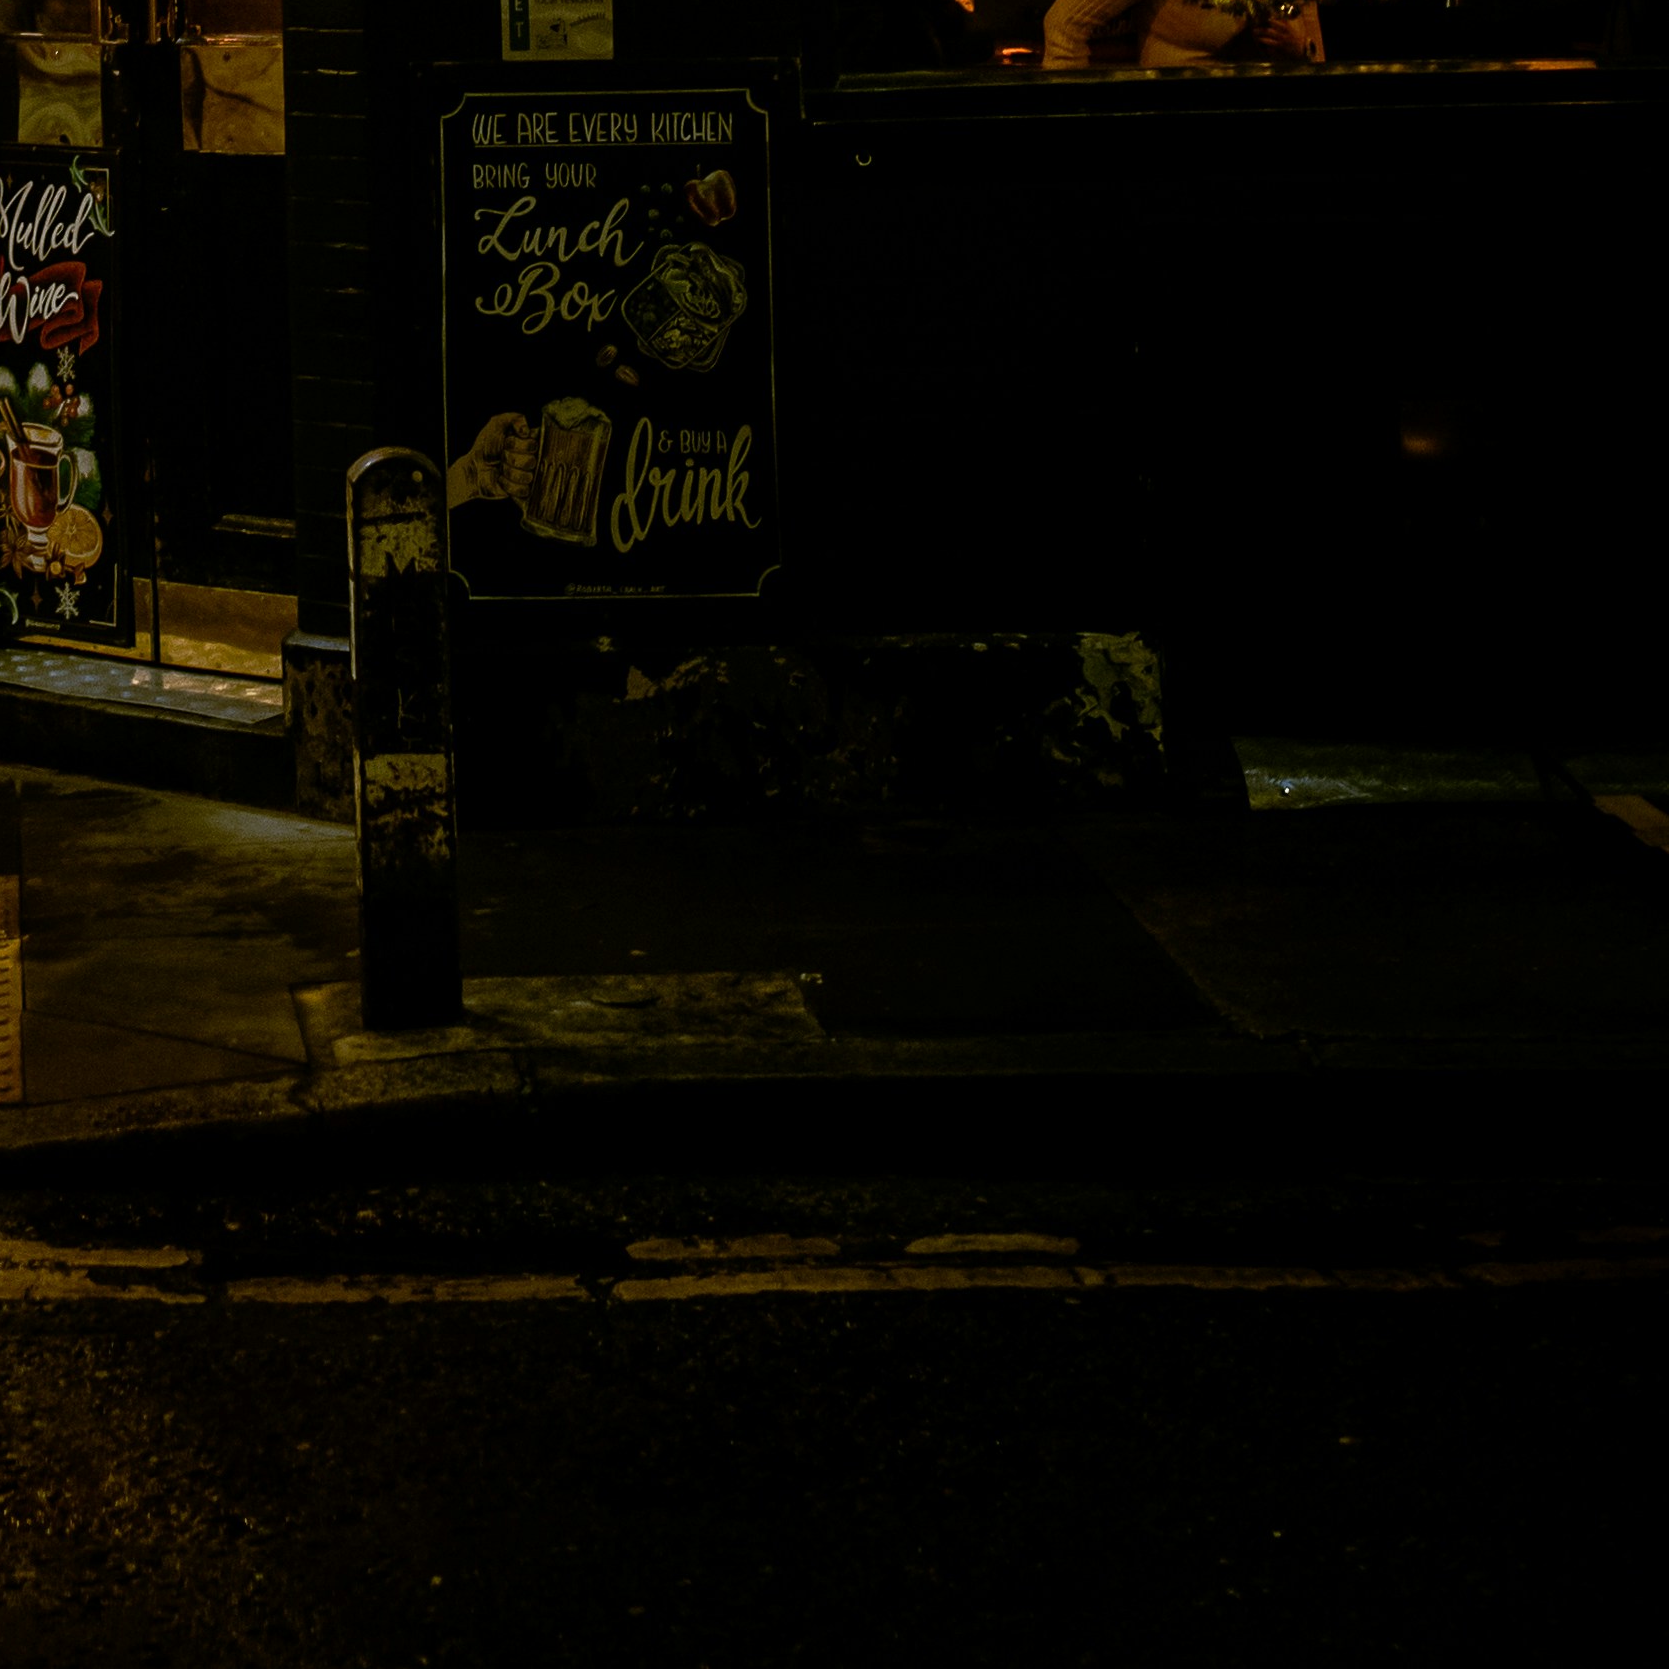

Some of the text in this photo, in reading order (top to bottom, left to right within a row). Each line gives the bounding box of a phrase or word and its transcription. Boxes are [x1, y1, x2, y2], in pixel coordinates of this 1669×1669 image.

[471, 111, 734, 145] WE ARE EVERY KITCHEN
[472, 162, 598, 189] BRING YOUR
[473, 195, 646, 267] Lunch
[474, 261, 621, 336] Box
[657, 429, 728, 455] & BUY A
[610, 415, 763, 554] drink
